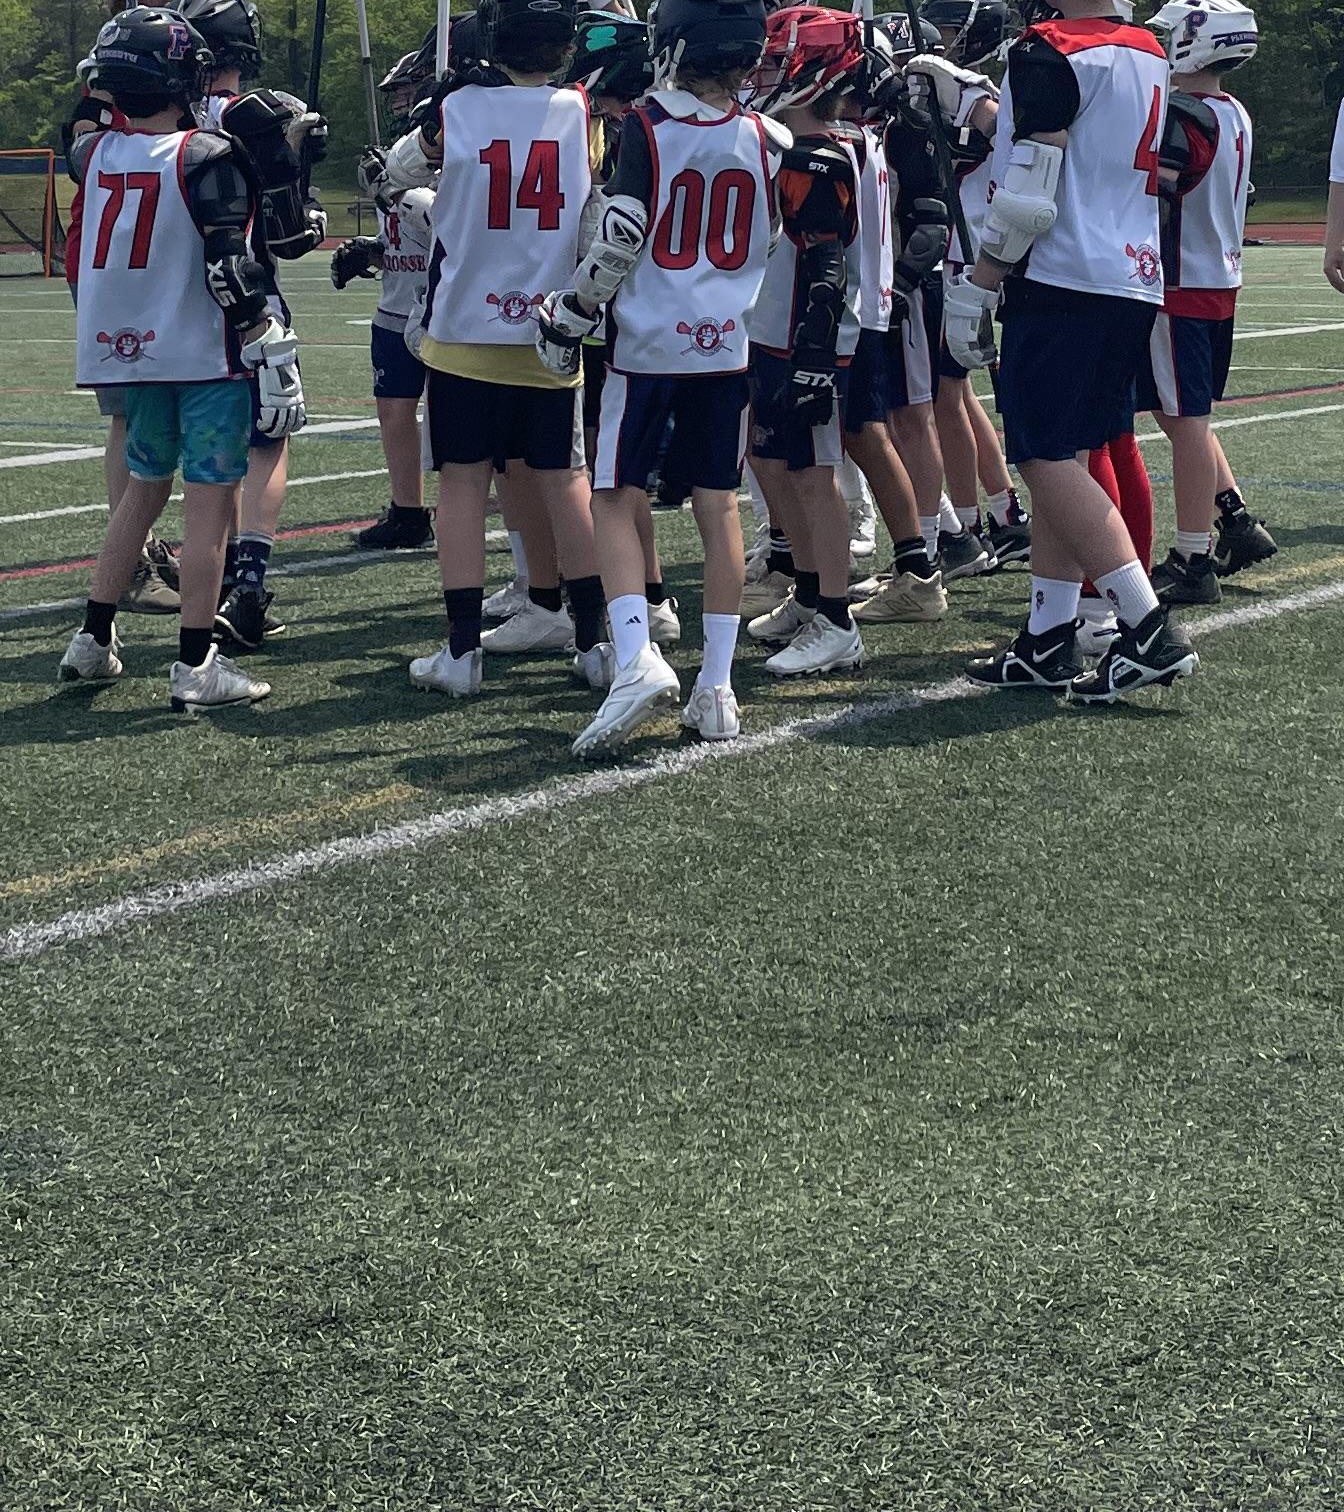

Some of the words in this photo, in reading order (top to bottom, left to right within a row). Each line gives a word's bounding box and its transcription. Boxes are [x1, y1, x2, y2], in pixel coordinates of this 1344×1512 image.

[1183, 9, 1208, 42] P
[808, 161, 830, 174] STX
[1133, 84, 1161, 197] 4
[92, 170, 161, 270] 77
[478, 139, 565, 231] 14
[651, 168, 757, 271] 00
[207, 259, 237, 307] STX
[792, 370, 835, 387] STX
